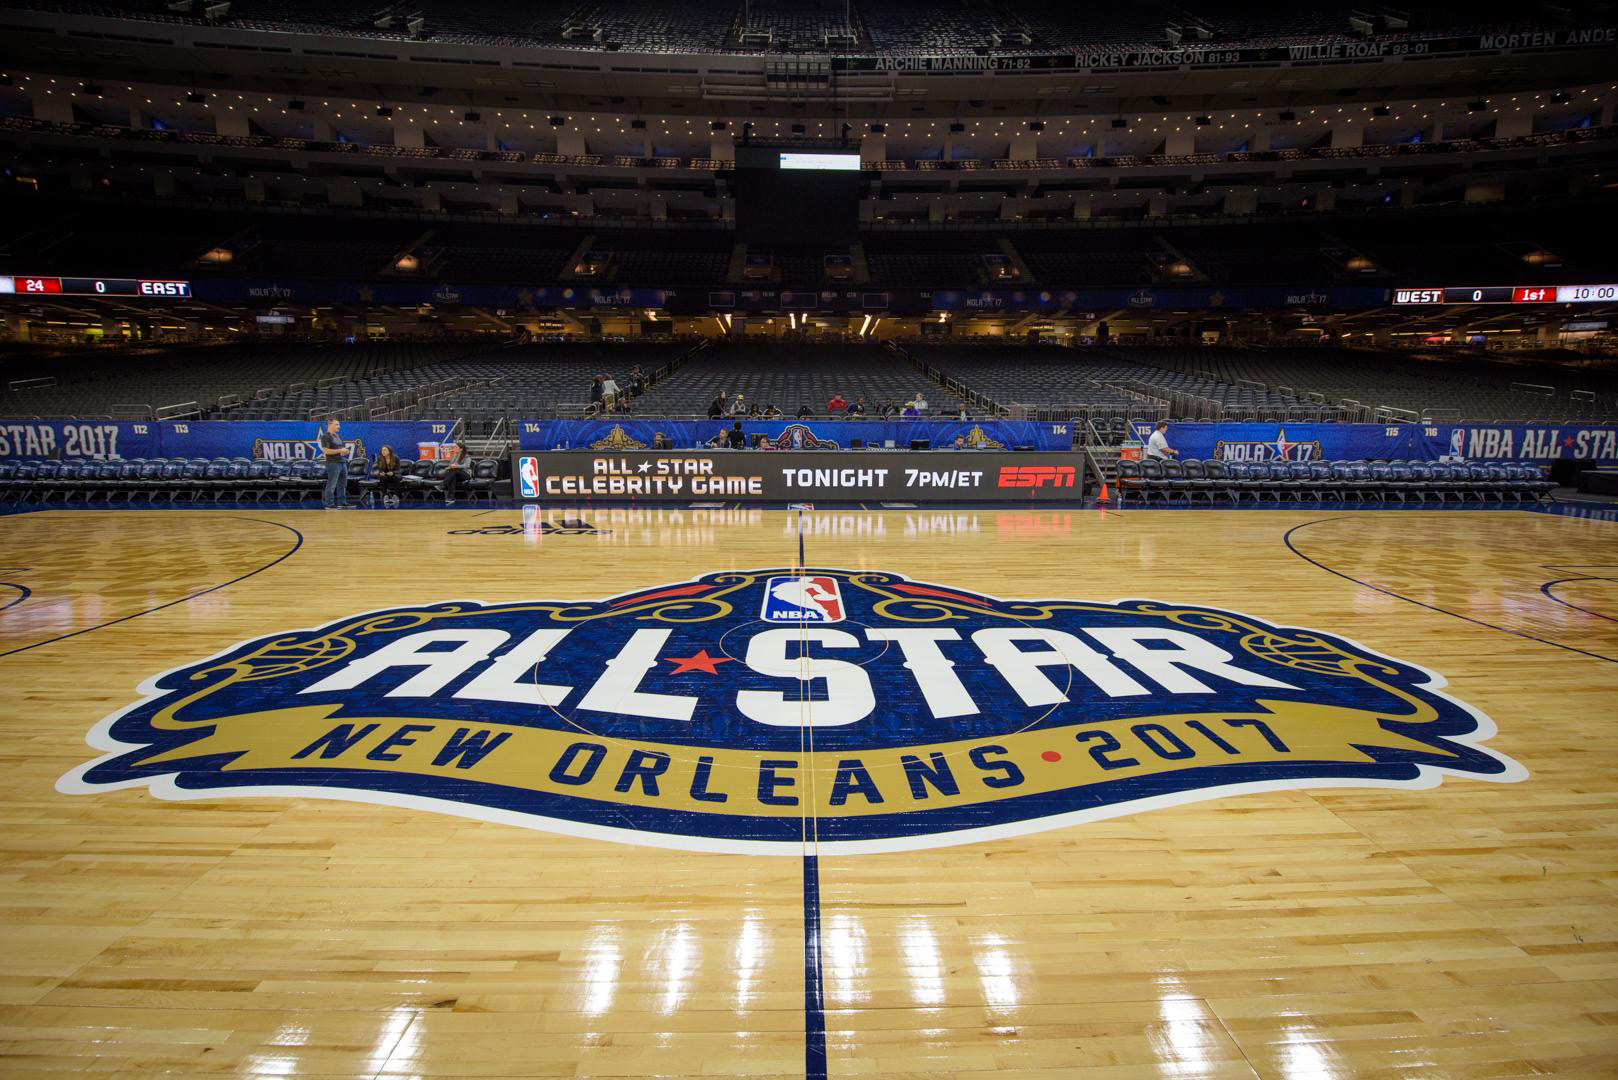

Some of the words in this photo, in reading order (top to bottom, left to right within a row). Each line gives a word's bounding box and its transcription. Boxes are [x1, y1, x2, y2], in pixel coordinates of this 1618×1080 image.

[1480, 32, 1556, 49] MORTEN
[1289, 45, 1343, 60] WILLIE
[1347, 43, 1392, 57] ROAF
[1393, 42, 1429, 55] 93-01
[875, 57, 928, 71] ARCHIE
[930, 56, 999, 70] MANNING
[1002, 58, 1031, 69] 71-82
[1074, 54, 1129, 67] RICKEY
[1133, 52, 1205, 66] JACKSON
[1208, 52, 1240, 63] 81-93
[26, 279, 44, 292] 24
[95, 281, 106, 294] 0
[141, 282, 187, 295] EAST
[249, 287, 269, 297] NOLA
[1287, 295, 1305, 304] NOLA
[1396, 290, 1442, 303] WEST
[1472, 289, 1483, 302] 0
[1522, 289, 1546, 301] 1st
[1573, 287, 1615, 299] 10:00
[594, 295, 612, 305] NOLA
[966, 298, 983, 307] NOLA
[133, 424, 148, 434] 112
[173, 424, 189, 434] 113
[431, 424, 447, 434] 113
[524, 423, 540, 433] 114
[1052, 424, 1067, 435] 114
[1137, 425, 1151, 435] 115
[1385, 427, 1399, 437] 115
[1425, 427, 1438, 437] 116
[63, 424, 119, 457] 2017
[1468, 428, 1513, 458] NBA
[1520, 429, 1562, 459] ALL
[262, 442, 306, 460] NOLA
[1223, 444, 1265, 462] NOLA
[1297, 444, 1313, 462] 17
[593, 458, 633, 474] ALL
[656, 458, 713, 474] STAR
[782, 468, 888, 487] TONIGHT
[904, 468, 983, 488] 7PM/ET
[997, 466, 1076, 487] ESPN
[545, 475, 683, 495] CELEBRITY
[692, 476, 762, 495] GAME
[447, 525, 613, 536] adidas
[772, 610, 819, 619] NBA
[295, 628, 699, 721] ALL
[736, 627, 1306, 727] STAR
[290, 723, 513, 770] NEW
[548, 742, 1026, 806] ORLEANS
[1075, 718, 1292, 771] 2017
